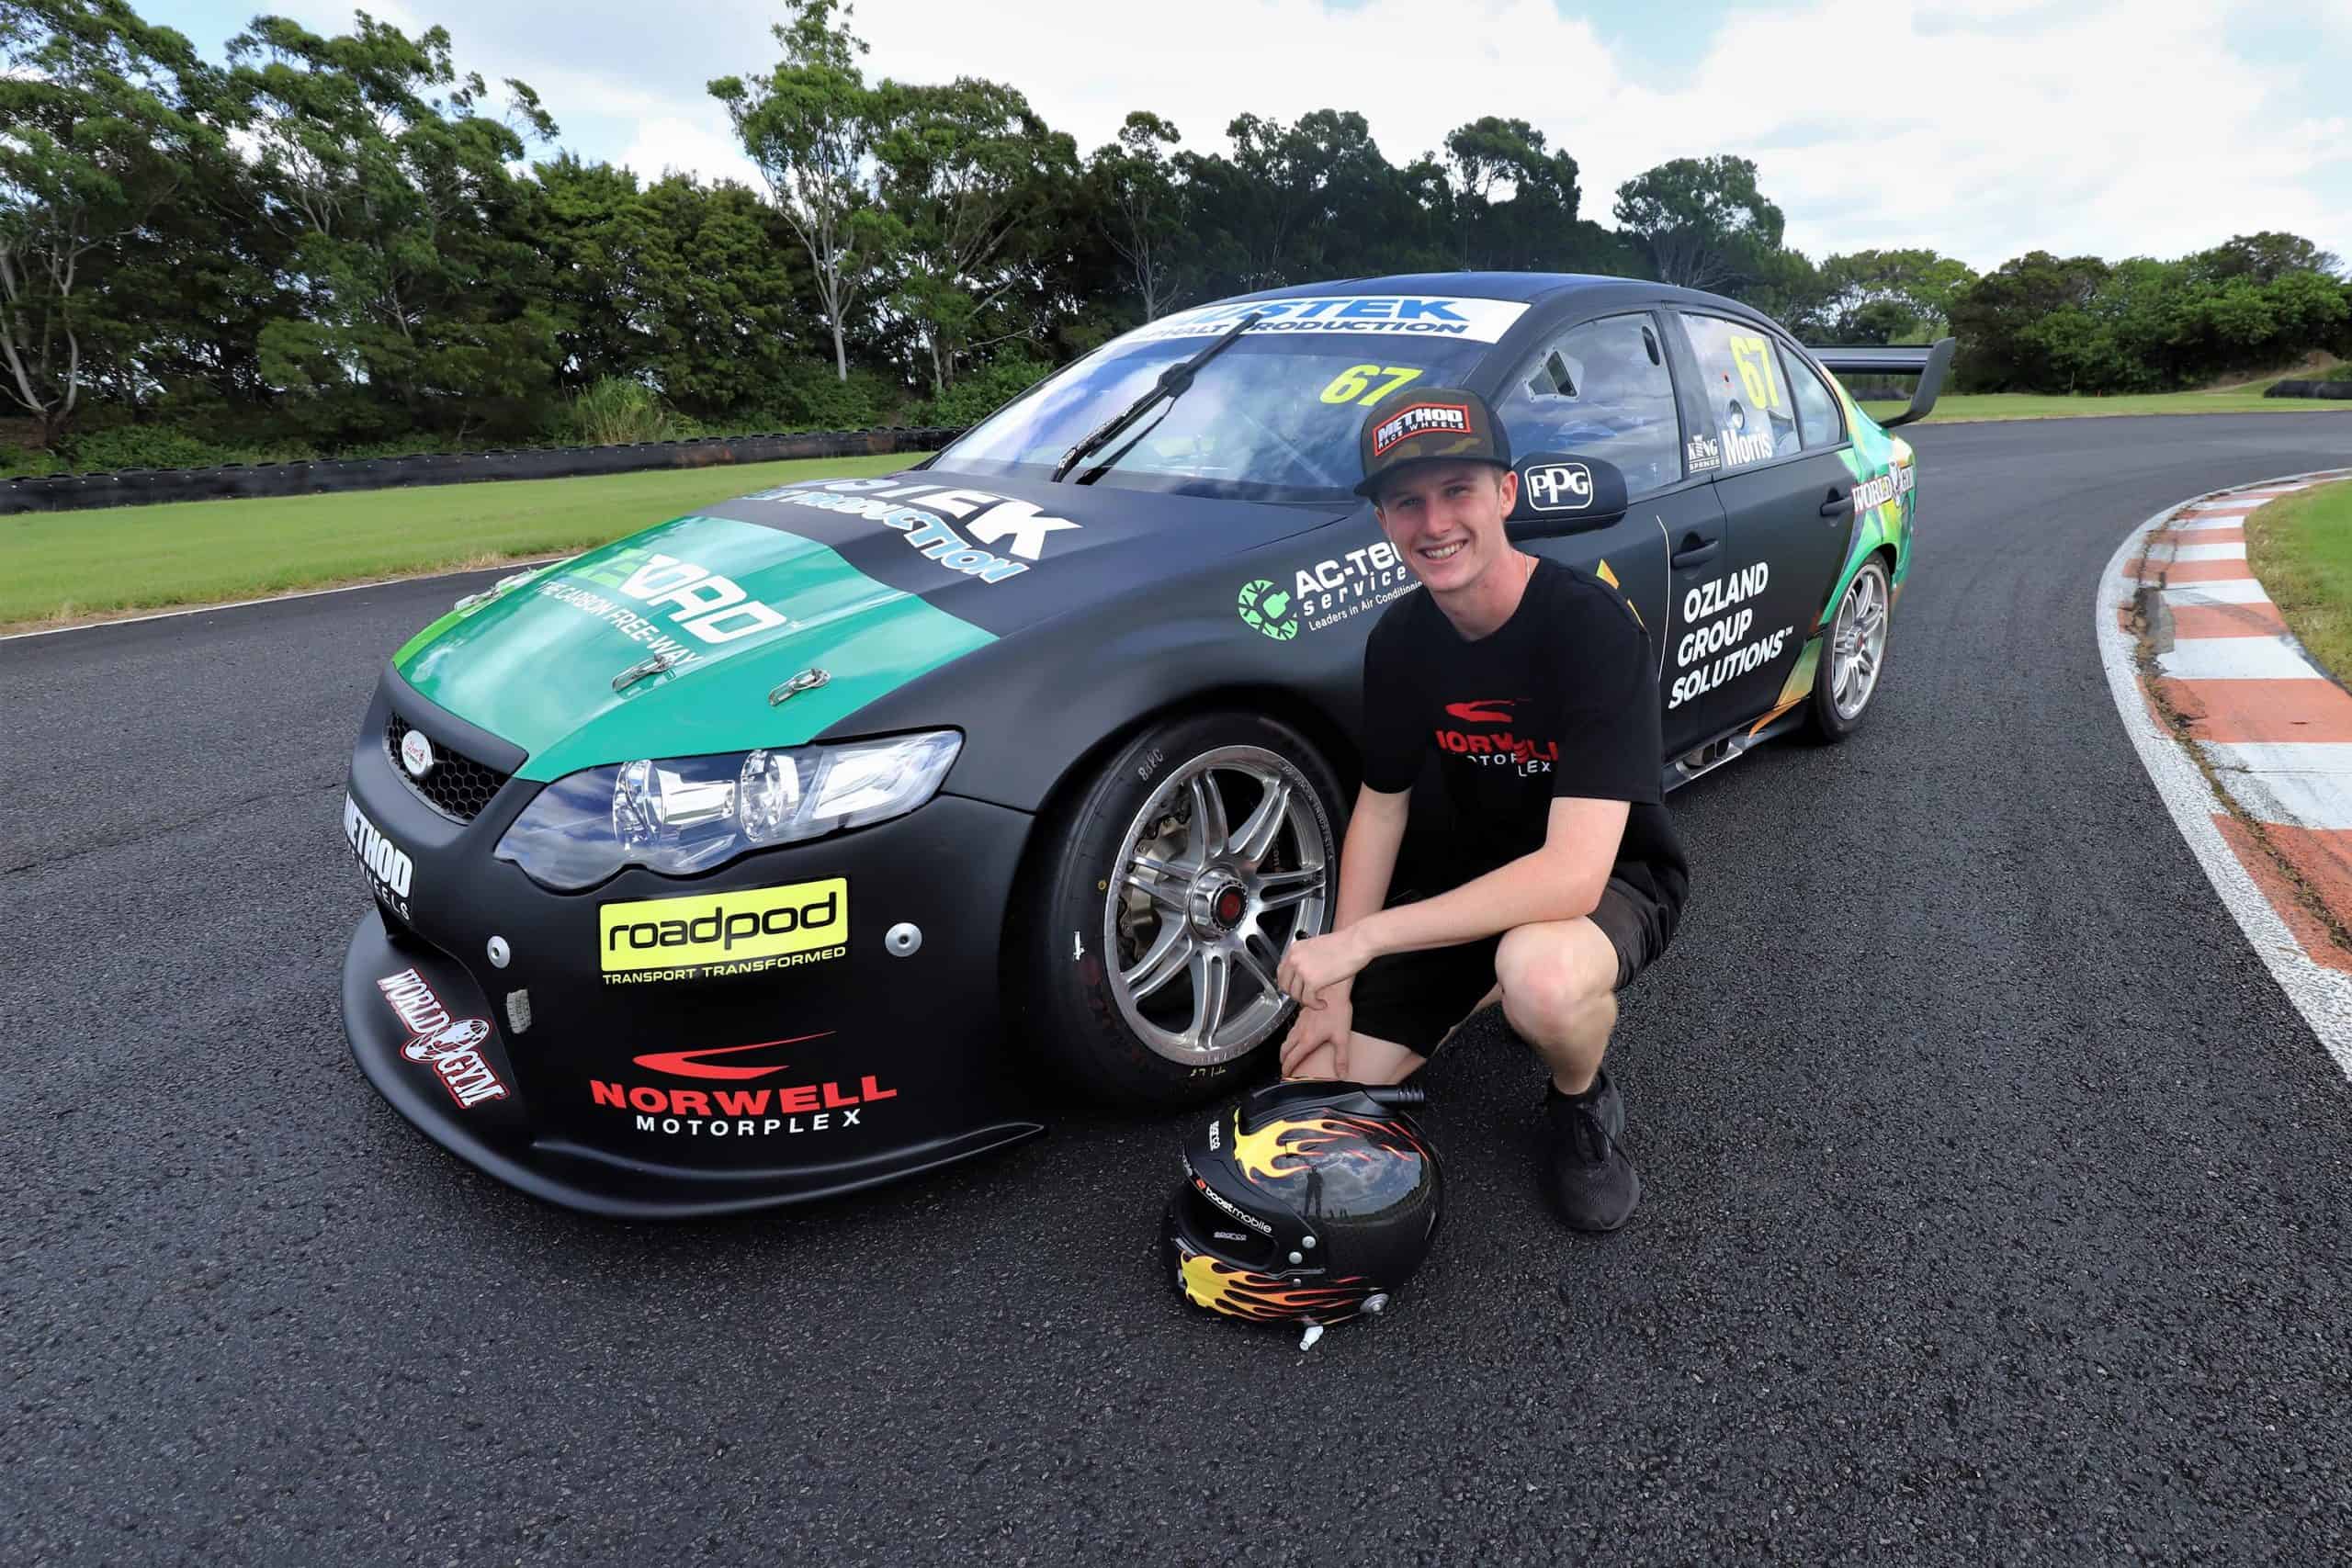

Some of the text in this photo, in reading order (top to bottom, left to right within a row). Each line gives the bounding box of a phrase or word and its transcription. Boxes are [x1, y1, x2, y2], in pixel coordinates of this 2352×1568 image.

[1248, 321, 1470, 333] RODUCTION
[1319, 365, 1423, 406] 67
[1730, 335, 1781, 410] 67
[1377, 408, 1464, 442] METHOD
[1721, 428, 1774, 467] Morris
[1530, 468, 1589, 504] PPG
[1852, 476, 1893, 513] WORLD
[1303, 565, 1407, 616] service
[1308, 580, 1424, 631] Leaders in Air Conditionin
[1683, 561, 1769, 624] OZLAND
[558, 587, 610, 616] CARBON
[603, 606, 706, 667] FREE-WAY
[1677, 608, 1753, 668] GROUP
[344, 789, 413, 898] METHOD
[607, 891, 838, 952] roadpod
[603, 946, 846, 986] TRANSPORT TRANSFORMED
[377, 967, 505, 1107] WORLD GYM
[589, 1074, 899, 1118] NORWELL
[636, 1109, 861, 1136] MOTORPLEX
